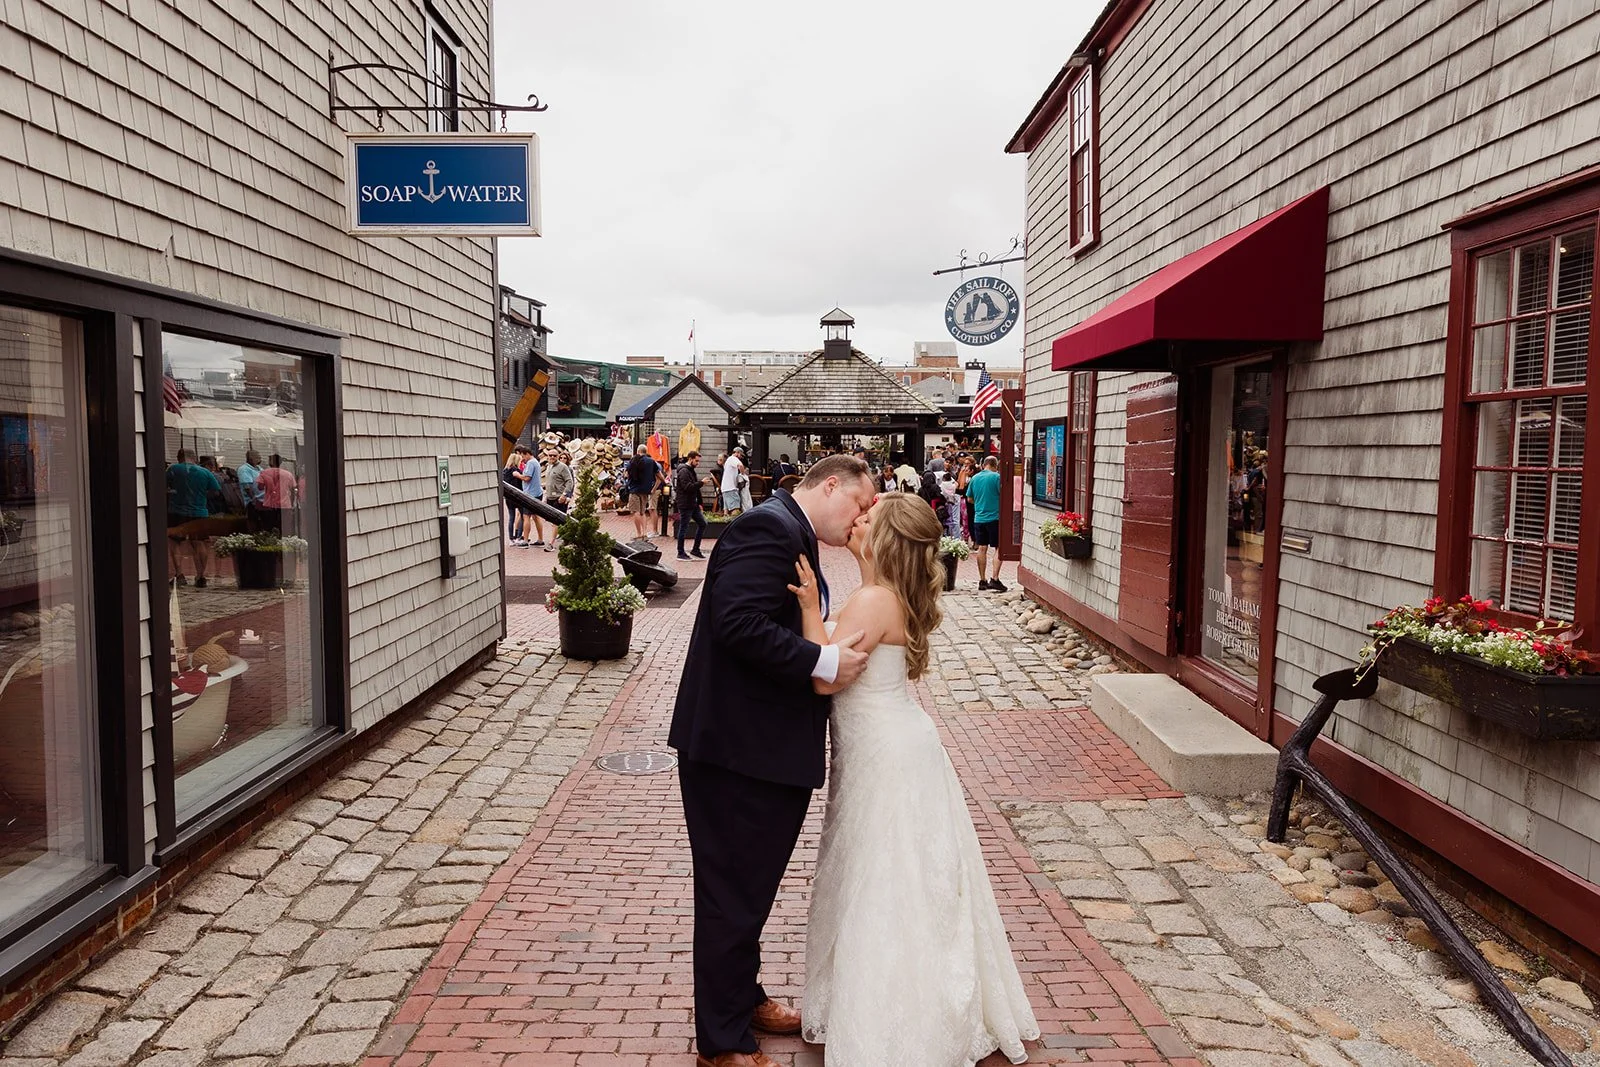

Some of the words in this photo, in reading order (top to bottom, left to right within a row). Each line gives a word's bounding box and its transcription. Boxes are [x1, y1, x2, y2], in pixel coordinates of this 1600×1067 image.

[361, 185, 416, 203] SOAP
[447, 185, 525, 203] WATER
[947, 288, 965, 312] THE
[966, 278, 990, 292] SAIL
[992, 279, 1018, 304] LOFT
[951, 326, 997, 344] CLOTHING
[1000, 319, 1015, 333] CO.
[1208, 587, 1232, 608] TOMMY
[1233, 596, 1262, 620] BAHAM
[1205, 624, 1232, 648] ROBERT
[1216, 609, 1253, 637] BRIGHTON
